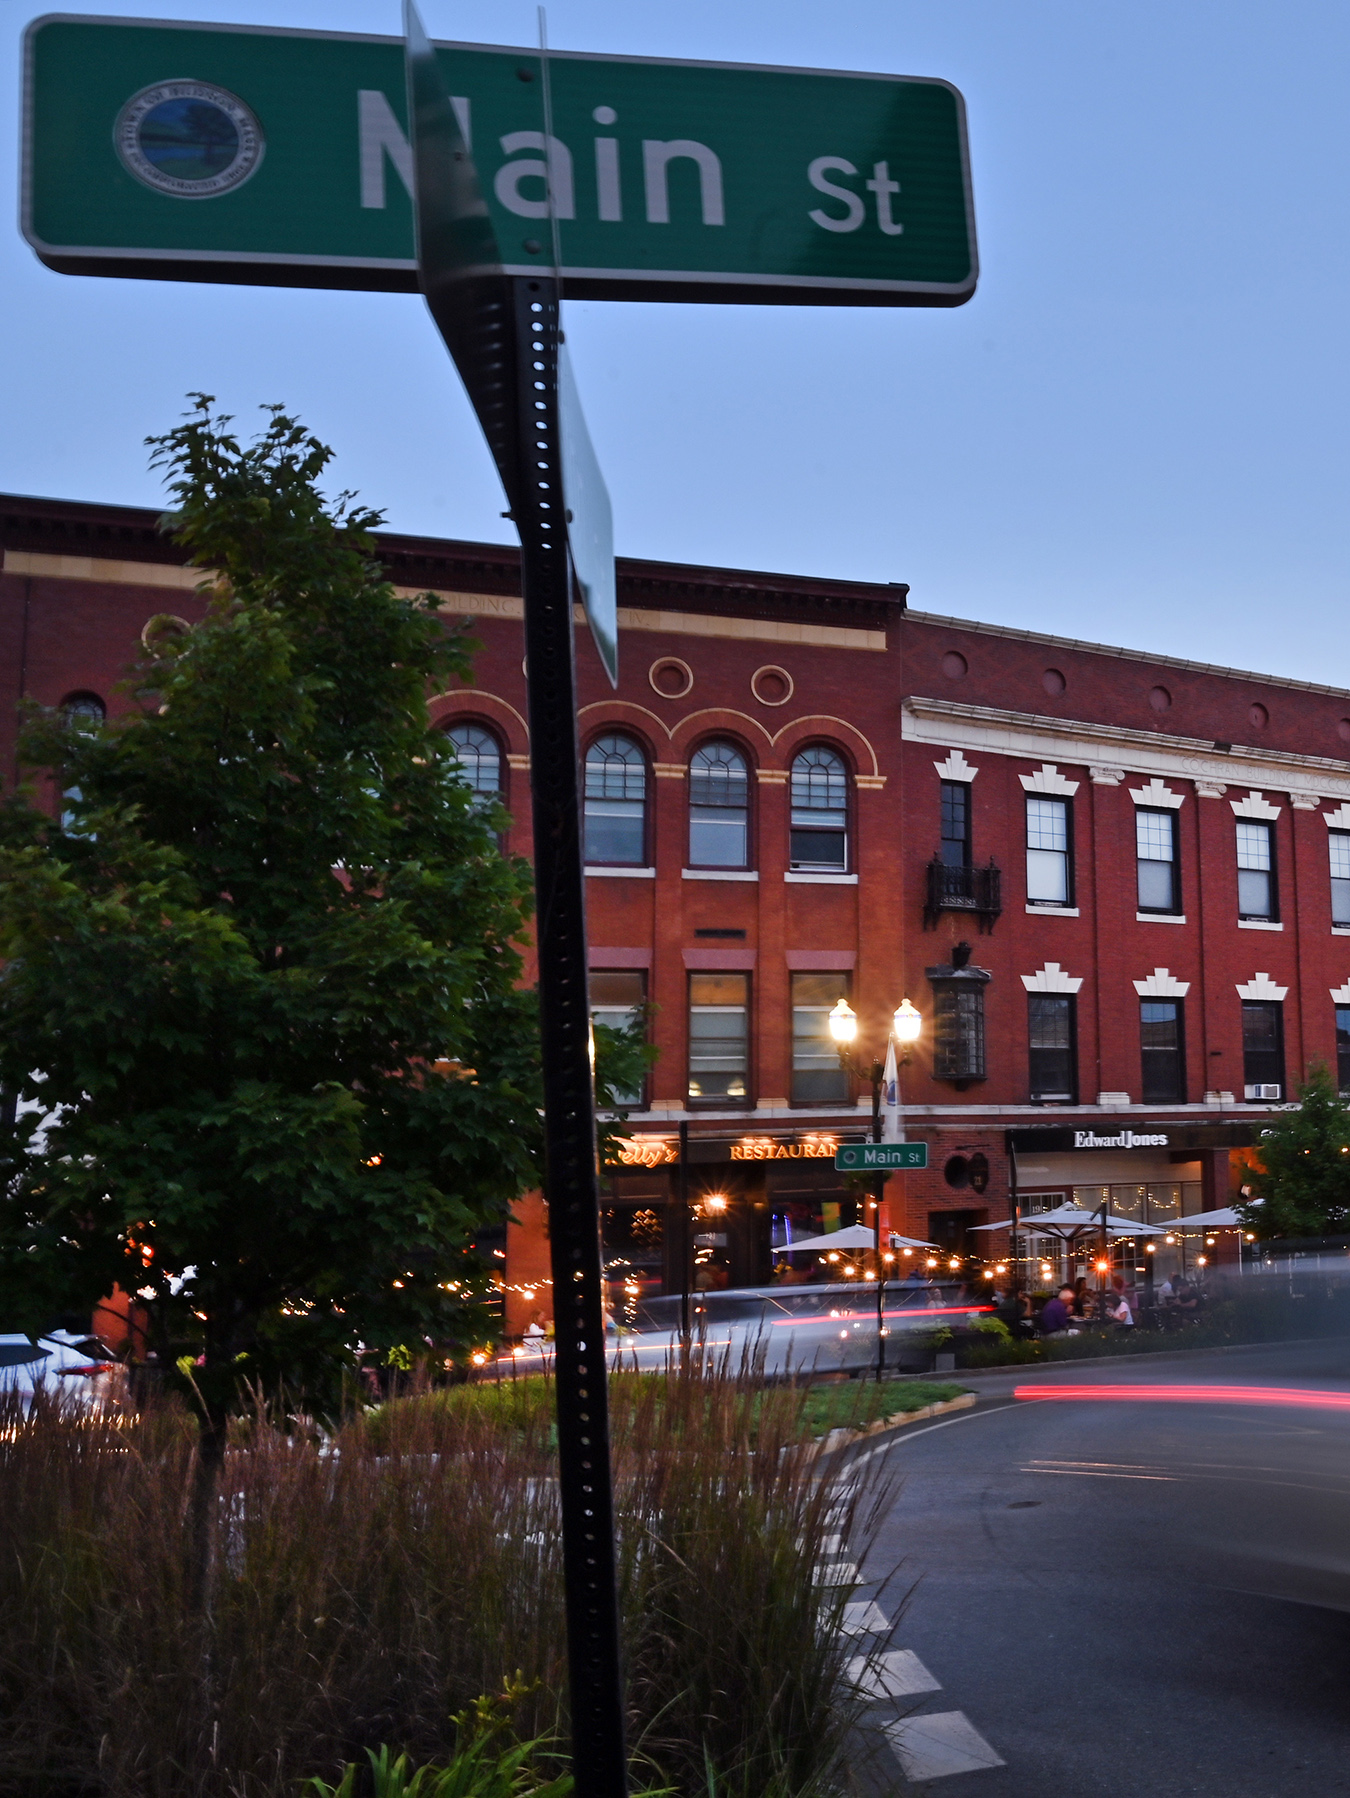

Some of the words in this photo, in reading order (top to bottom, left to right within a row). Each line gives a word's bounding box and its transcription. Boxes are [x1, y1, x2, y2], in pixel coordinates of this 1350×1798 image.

[807, 155, 904, 235] St
[605, 1145, 679, 1168] elly's
[729, 1143, 839, 1161] RESTAURAN
[864, 1149, 902, 1164] Main
[908, 1152, 921, 1164] St
[1032, 1205, 1041, 1214] 19
